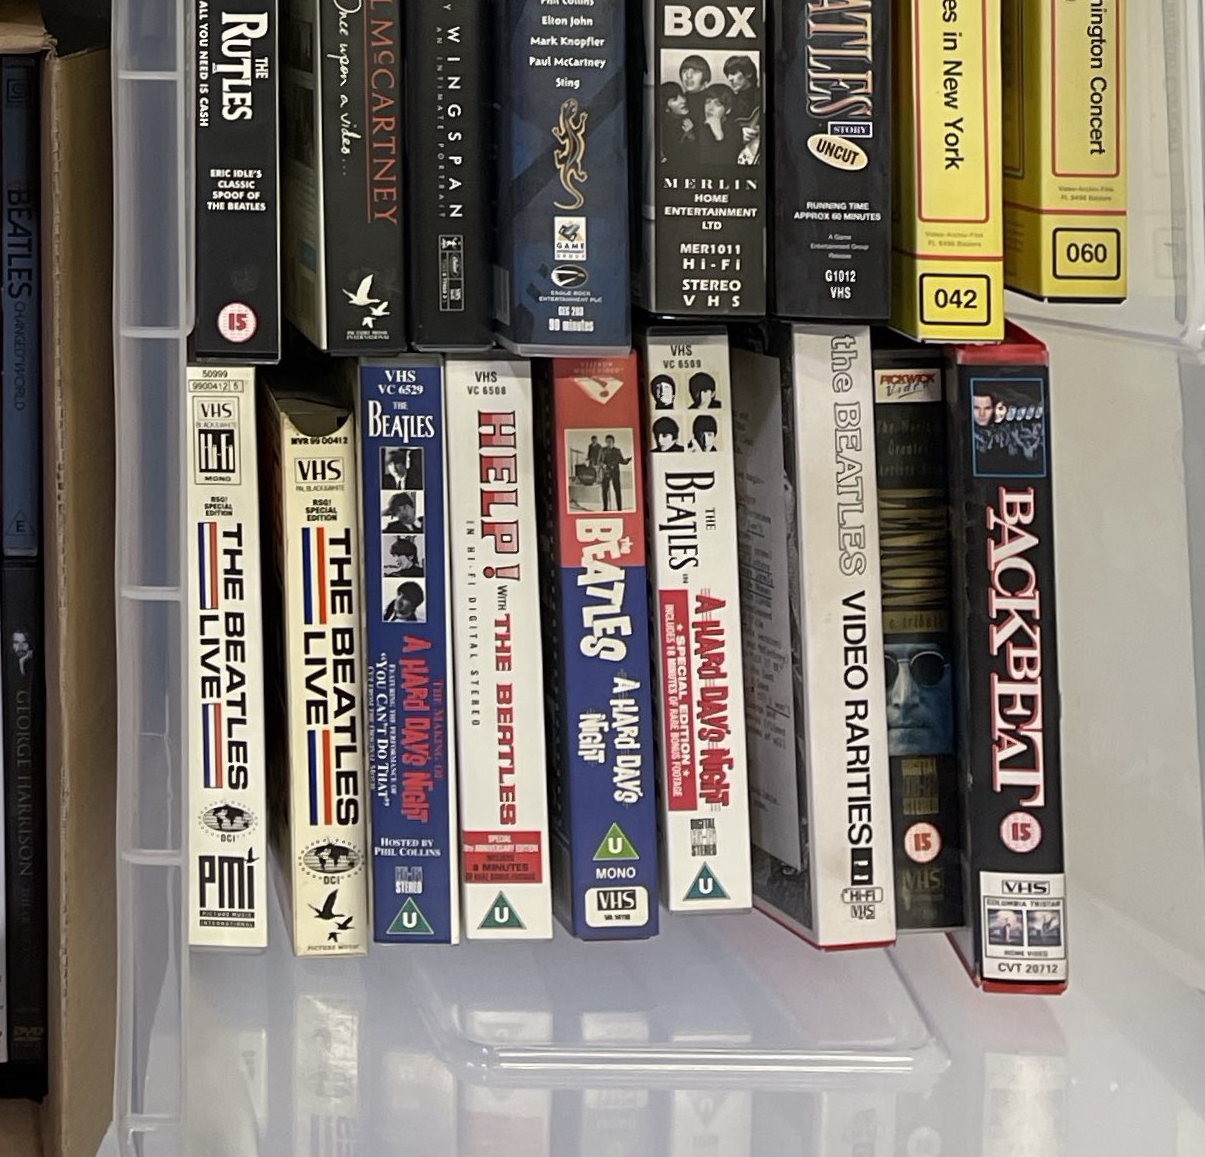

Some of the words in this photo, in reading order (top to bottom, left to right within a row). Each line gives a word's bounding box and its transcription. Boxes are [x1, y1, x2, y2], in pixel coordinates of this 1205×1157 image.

[664, 5, 756, 38] BOX
[943, 31, 963, 51] in
[212, 12, 269, 121] RUTLES
[556, 78, 580, 89] Sting
[943, 60, 963, 110] New
[1090, 76, 1107, 155] Concert
[816, 139, 859, 165] UNCUT
[945, 118, 964, 171] York
[218, 181, 255, 189] CLASSIC
[665, 207, 757, 217] ENTERTAINMENT
[680, 244, 741, 254] MER1011
[1066, 244, 1107, 263] 060
[934, 289, 977, 309] 042
[831, 334, 858, 393] the
[378, 385, 396, 394] VC
[398, 385, 423, 395] 6529
[368, 401, 435, 443] BEATLES
[298, 461, 341, 481] VHS
[835, 402, 866, 577] BEATLES
[478, 410, 520, 581] HELP!
[223, 523, 244, 601] THE
[199, 615, 221, 699] LIVE
[842, 590, 868, 689] VIDEO
[987, 487, 1045, 806] BACKBEAT
[224, 612, 248, 790] BEATLES
[845, 700, 872, 845] RARITIES
[596, 867, 636, 879] MONO
[998, 964, 1021, 973] CVT
[1025, 964, 1058, 973] 20712
